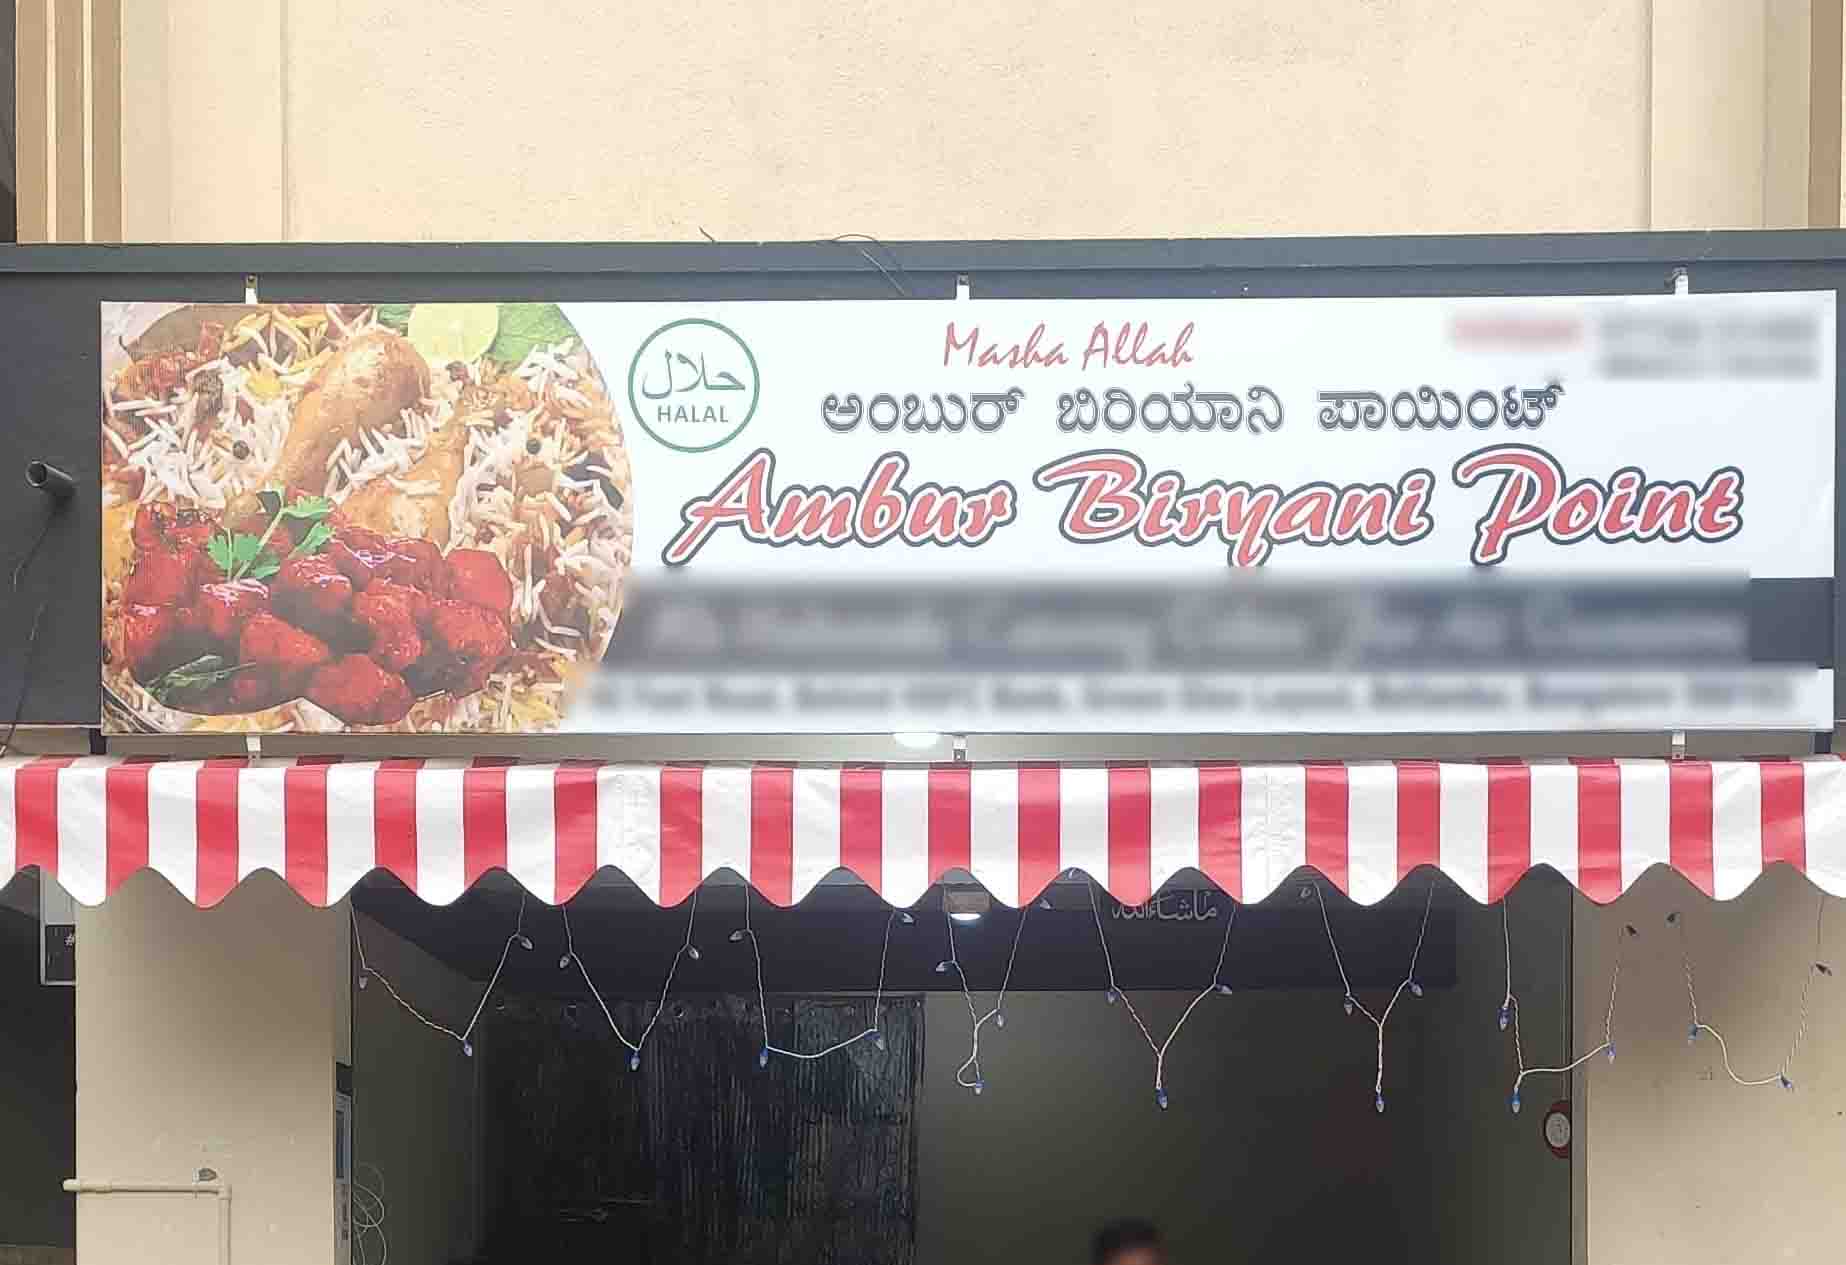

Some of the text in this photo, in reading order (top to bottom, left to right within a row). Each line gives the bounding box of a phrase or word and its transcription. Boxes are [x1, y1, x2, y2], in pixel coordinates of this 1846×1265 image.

[943, 320, 1195, 370] Masha Allah
[641, 348, 746, 400] حلال
[657, 404, 729, 423] HALAL
[1056, 380, 1285, 434] ಬಿರಿಯಾನಿ
[1316, 383, 1567, 431] ಪಾಯಿಂಟ್
[661, 443, 1744, 567] Ambur Biryani Point
